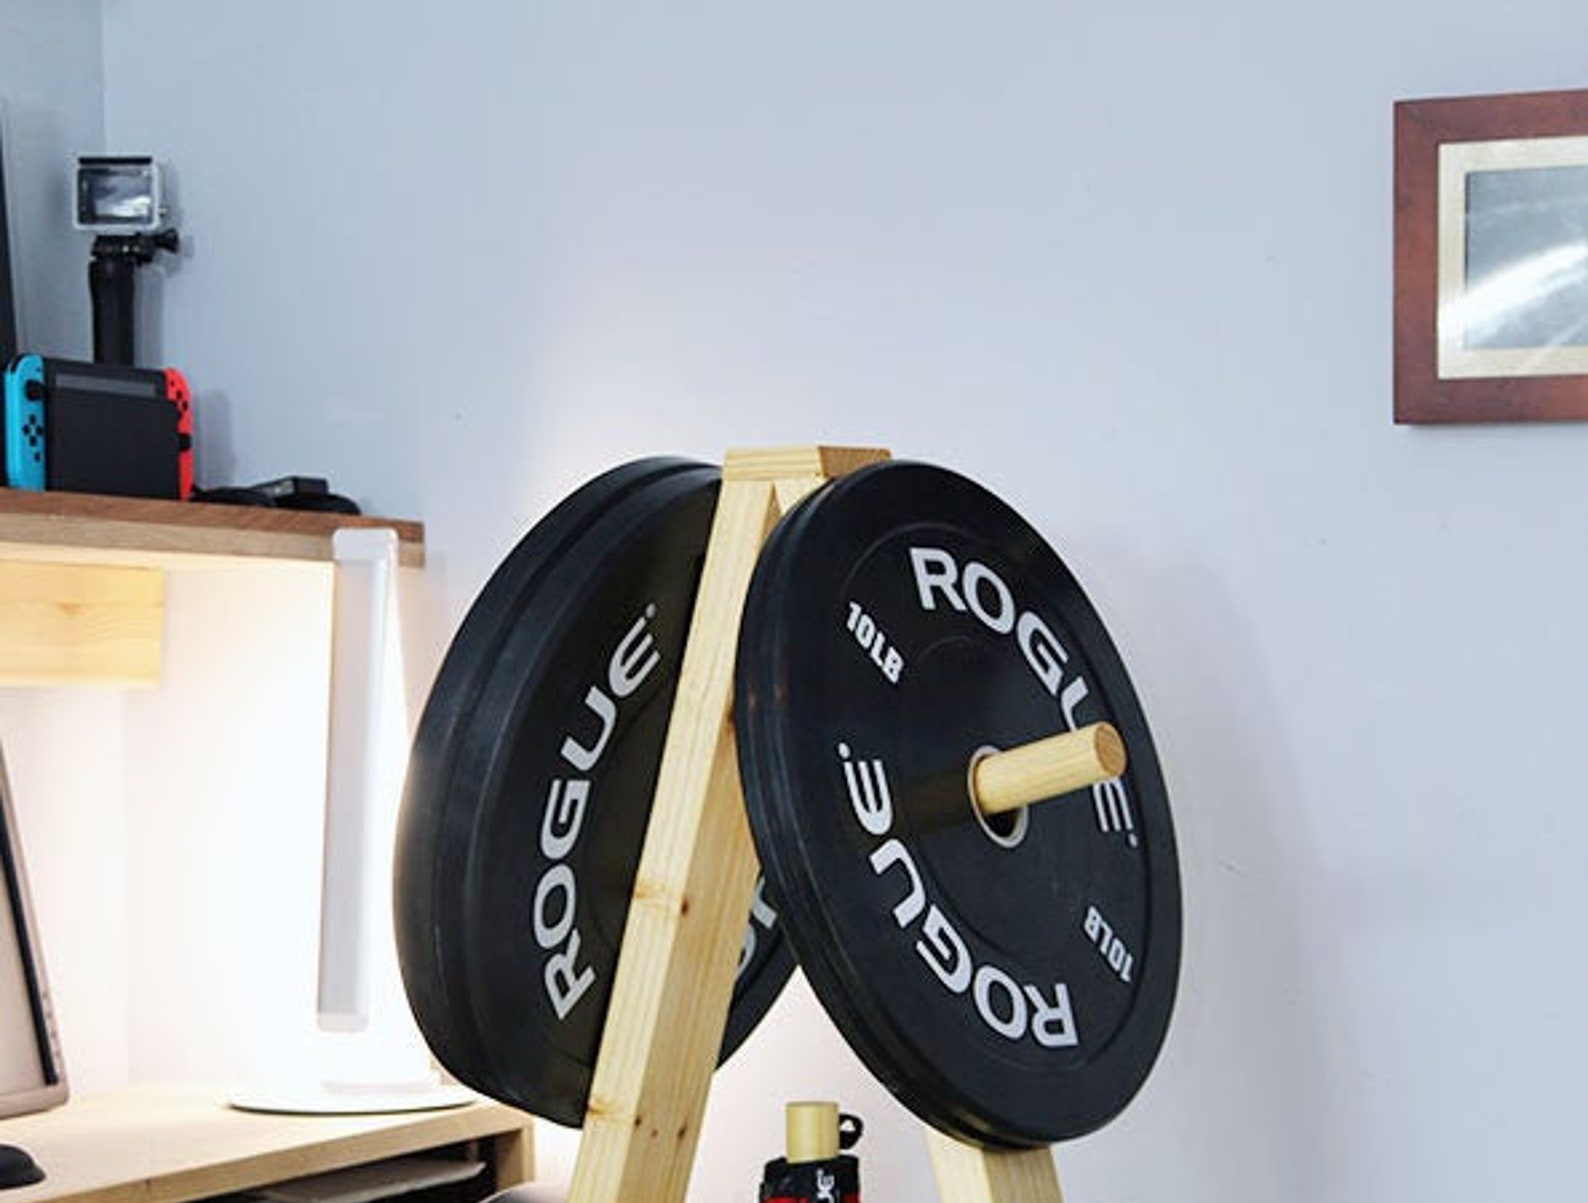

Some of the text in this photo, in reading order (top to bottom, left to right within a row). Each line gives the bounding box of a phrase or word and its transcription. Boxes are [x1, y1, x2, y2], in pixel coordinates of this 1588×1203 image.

[847, 602, 904, 683] 10LB
[534, 604, 660, 1020] ROGUE
[838, 743, 1079, 1046] ROGUE
[1083, 905, 1134, 982] 10LB
